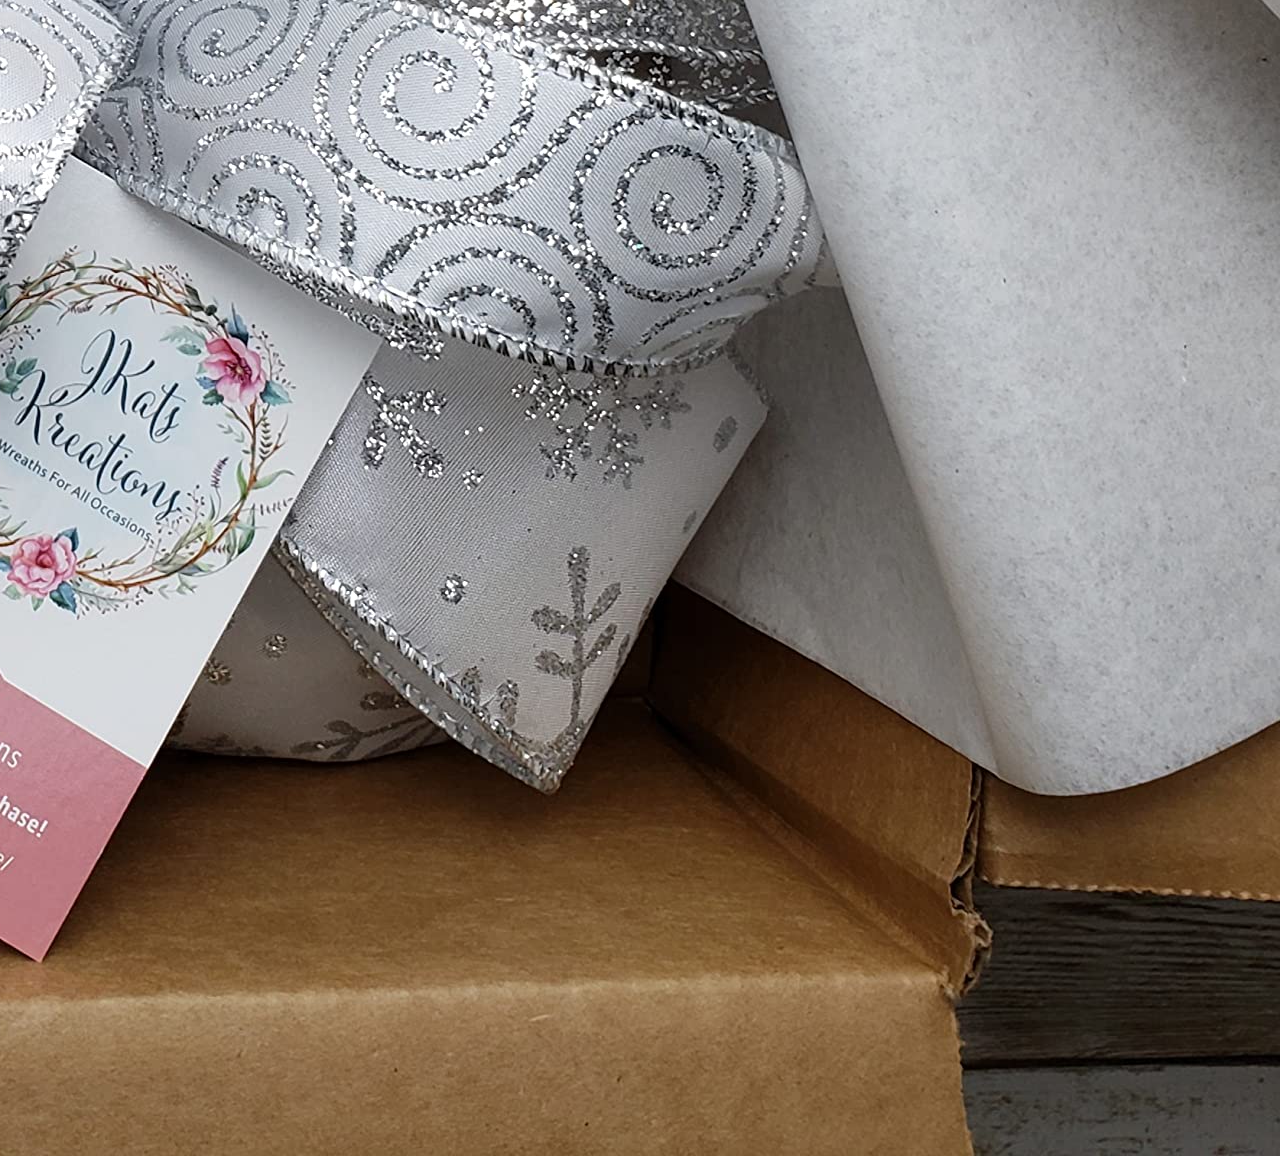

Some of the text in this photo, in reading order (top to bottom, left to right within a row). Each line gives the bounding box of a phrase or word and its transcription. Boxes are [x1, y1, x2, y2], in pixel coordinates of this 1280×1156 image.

[11, 369, 180, 521] Kreations
[49, 471, 73, 492] For
[70, 487, 92, 504] All
[90, 497, 153, 542] Occasions
